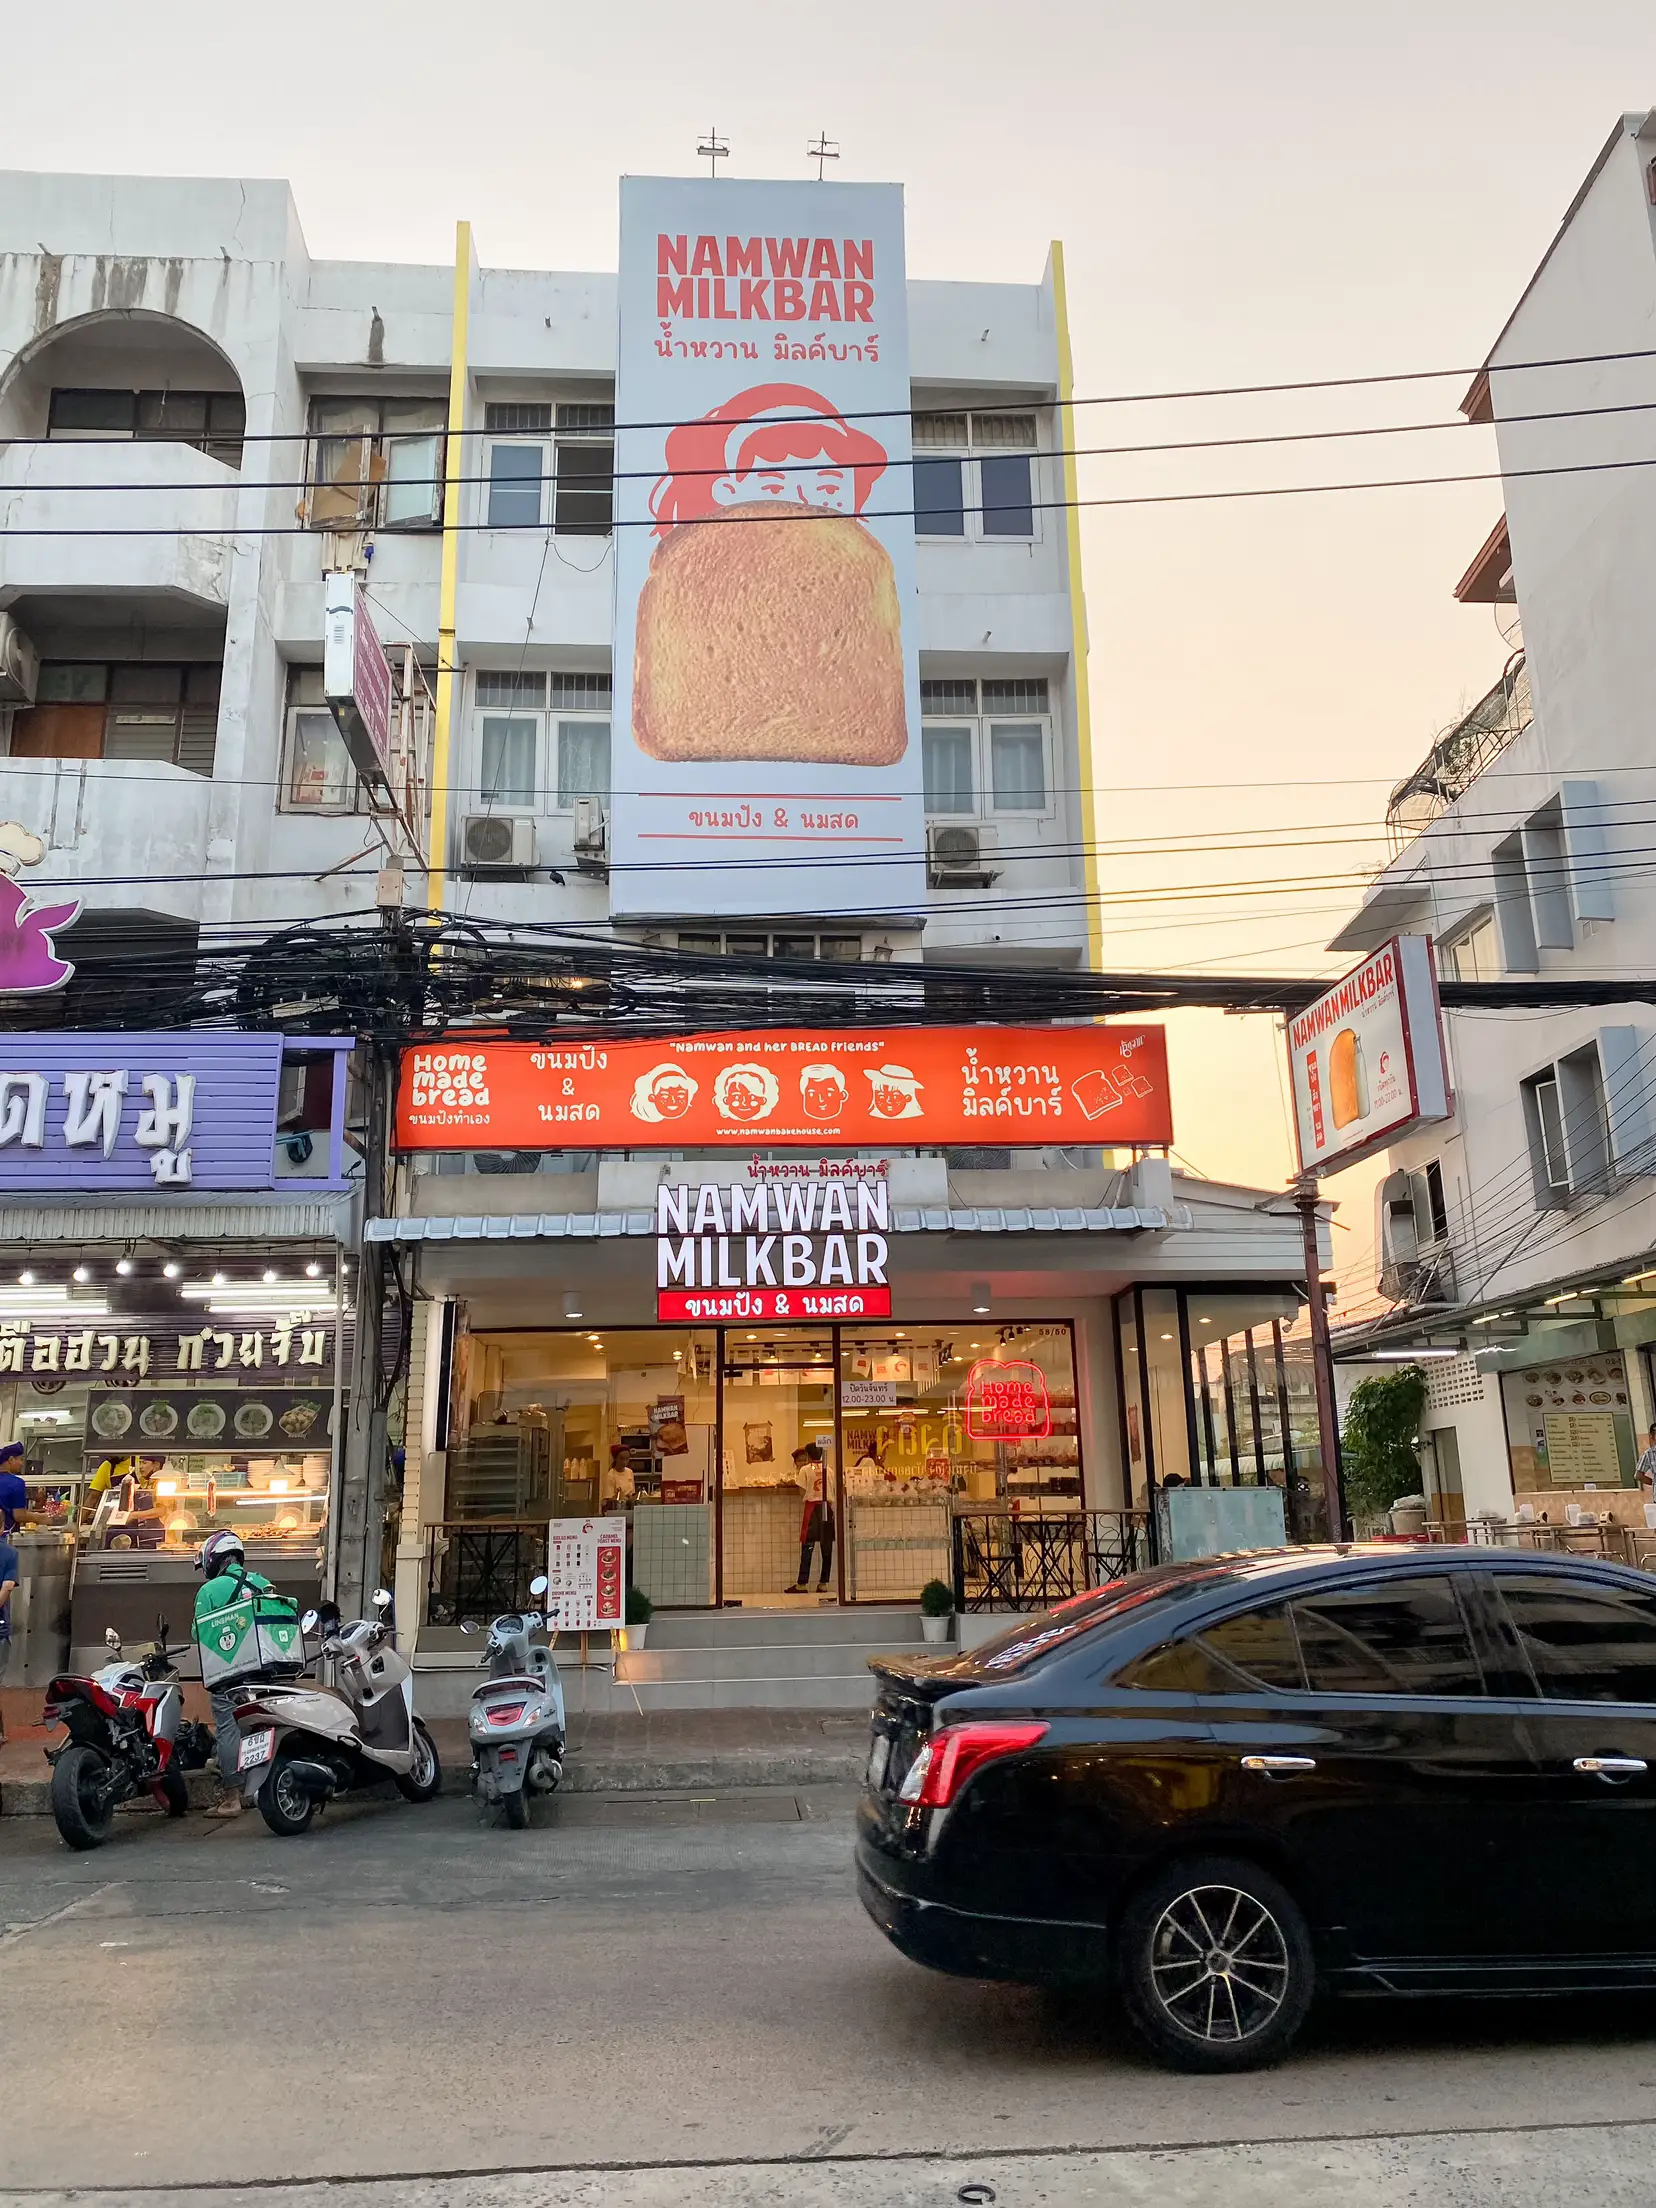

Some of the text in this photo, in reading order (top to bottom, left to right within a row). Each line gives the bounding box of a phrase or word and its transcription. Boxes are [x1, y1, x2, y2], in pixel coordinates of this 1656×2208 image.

[657, 233, 874, 280] NAMWAN
[657, 277, 875, 322] MILKBAR
[654, 321, 879, 362] น้ำหวาน มิลค์บาร์
[688, 804, 859, 829] ขนมปัง & นมสด
[736, 1042, 761, 1052] and
[764, 1042, 787, 1052] her
[790, 1041, 828, 1052] BREAD
[413, 1053, 488, 1073] Home
[530, 1045, 607, 1070] ขนมปัง
[961, 1047, 1059, 1085] น้ำหวาน
[412, 1070, 485, 1090] made
[561, 1077, 576, 1096] &
[411, 1087, 490, 1107] bread
[960, 1086, 1062, 1117] มิลค์บาร์
[408, 1109, 490, 1125] ขนมปังทำเอง
[537, 1102, 600, 1122] นมสด
[716, 1127, 841, 1136] www.namwanbakehouse.com
[747, 1153, 888, 1178] น้ำหวาน มิลค์บาร์
[657, 1180, 889, 1234] NAMWAN
[657, 1233, 889, 1288] MILKBAR
[685, 1291, 864, 1316] ขนมปัง & นมสด
[981, 1380, 1036, 1394] Home
[842, 1395, 886, 1403] 12.00-23.00
[981, 1394, 1036, 1408] made
[981, 1408, 1036, 1425] bread
